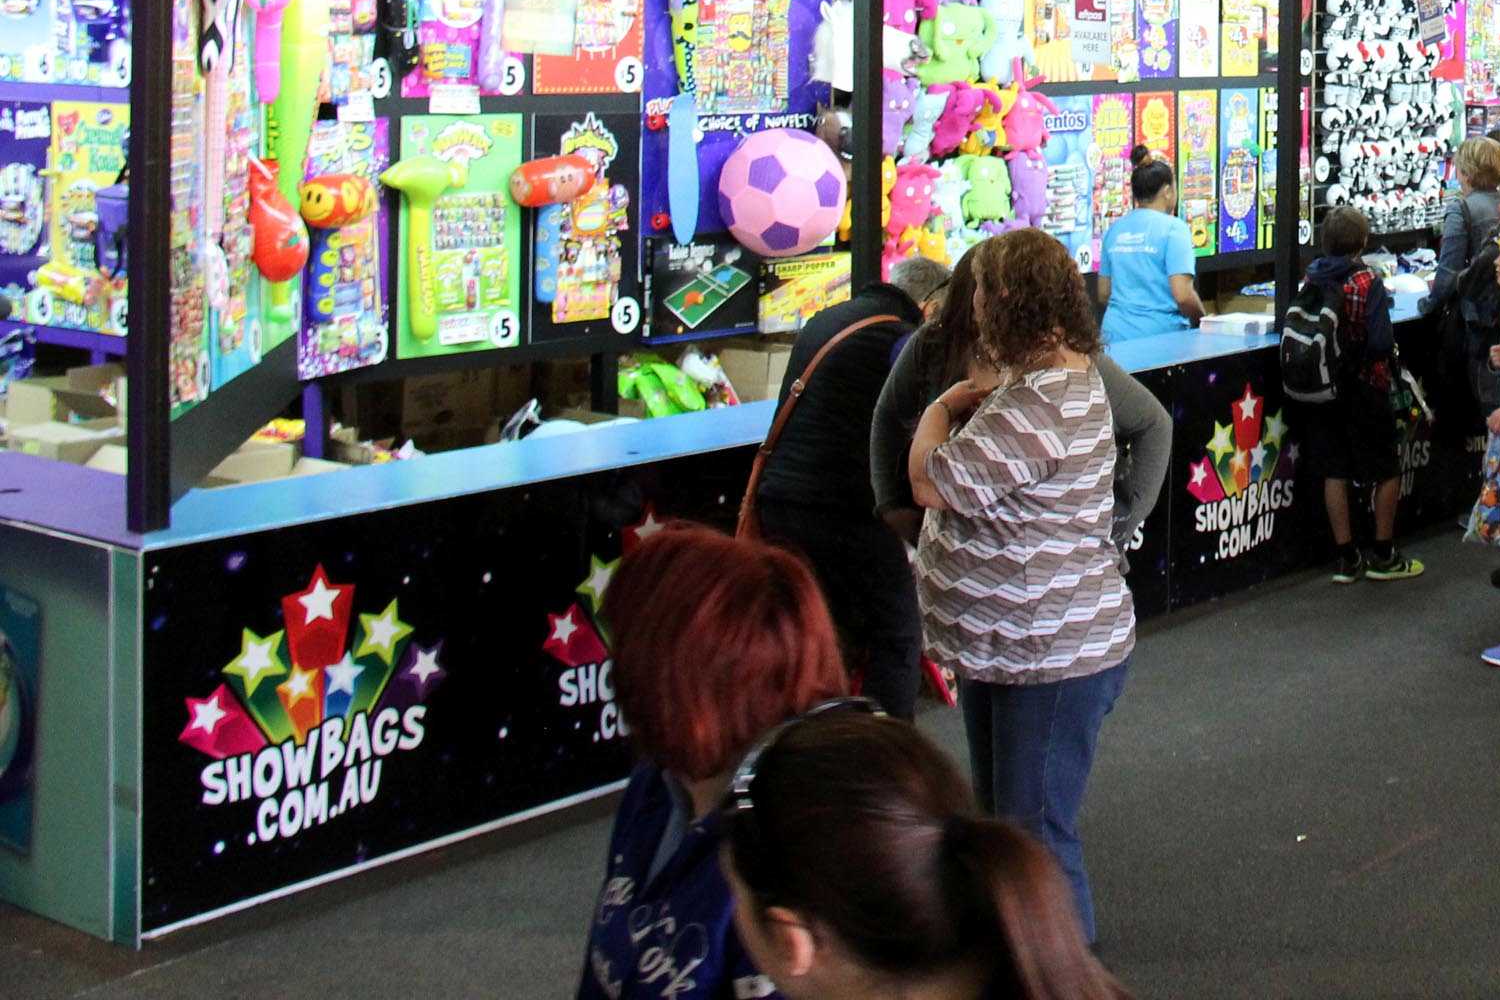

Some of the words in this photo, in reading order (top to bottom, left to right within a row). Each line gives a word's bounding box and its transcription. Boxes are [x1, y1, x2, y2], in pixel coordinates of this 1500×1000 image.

[1044, 111, 1086, 130] entos
[1195, 479, 1294, 531] SHOWBAGS
[1215, 511, 1274, 560] .COM.AU
[201, 704, 427, 805] SHOWBAGS
[247, 758, 383, 846] .COM.AU
